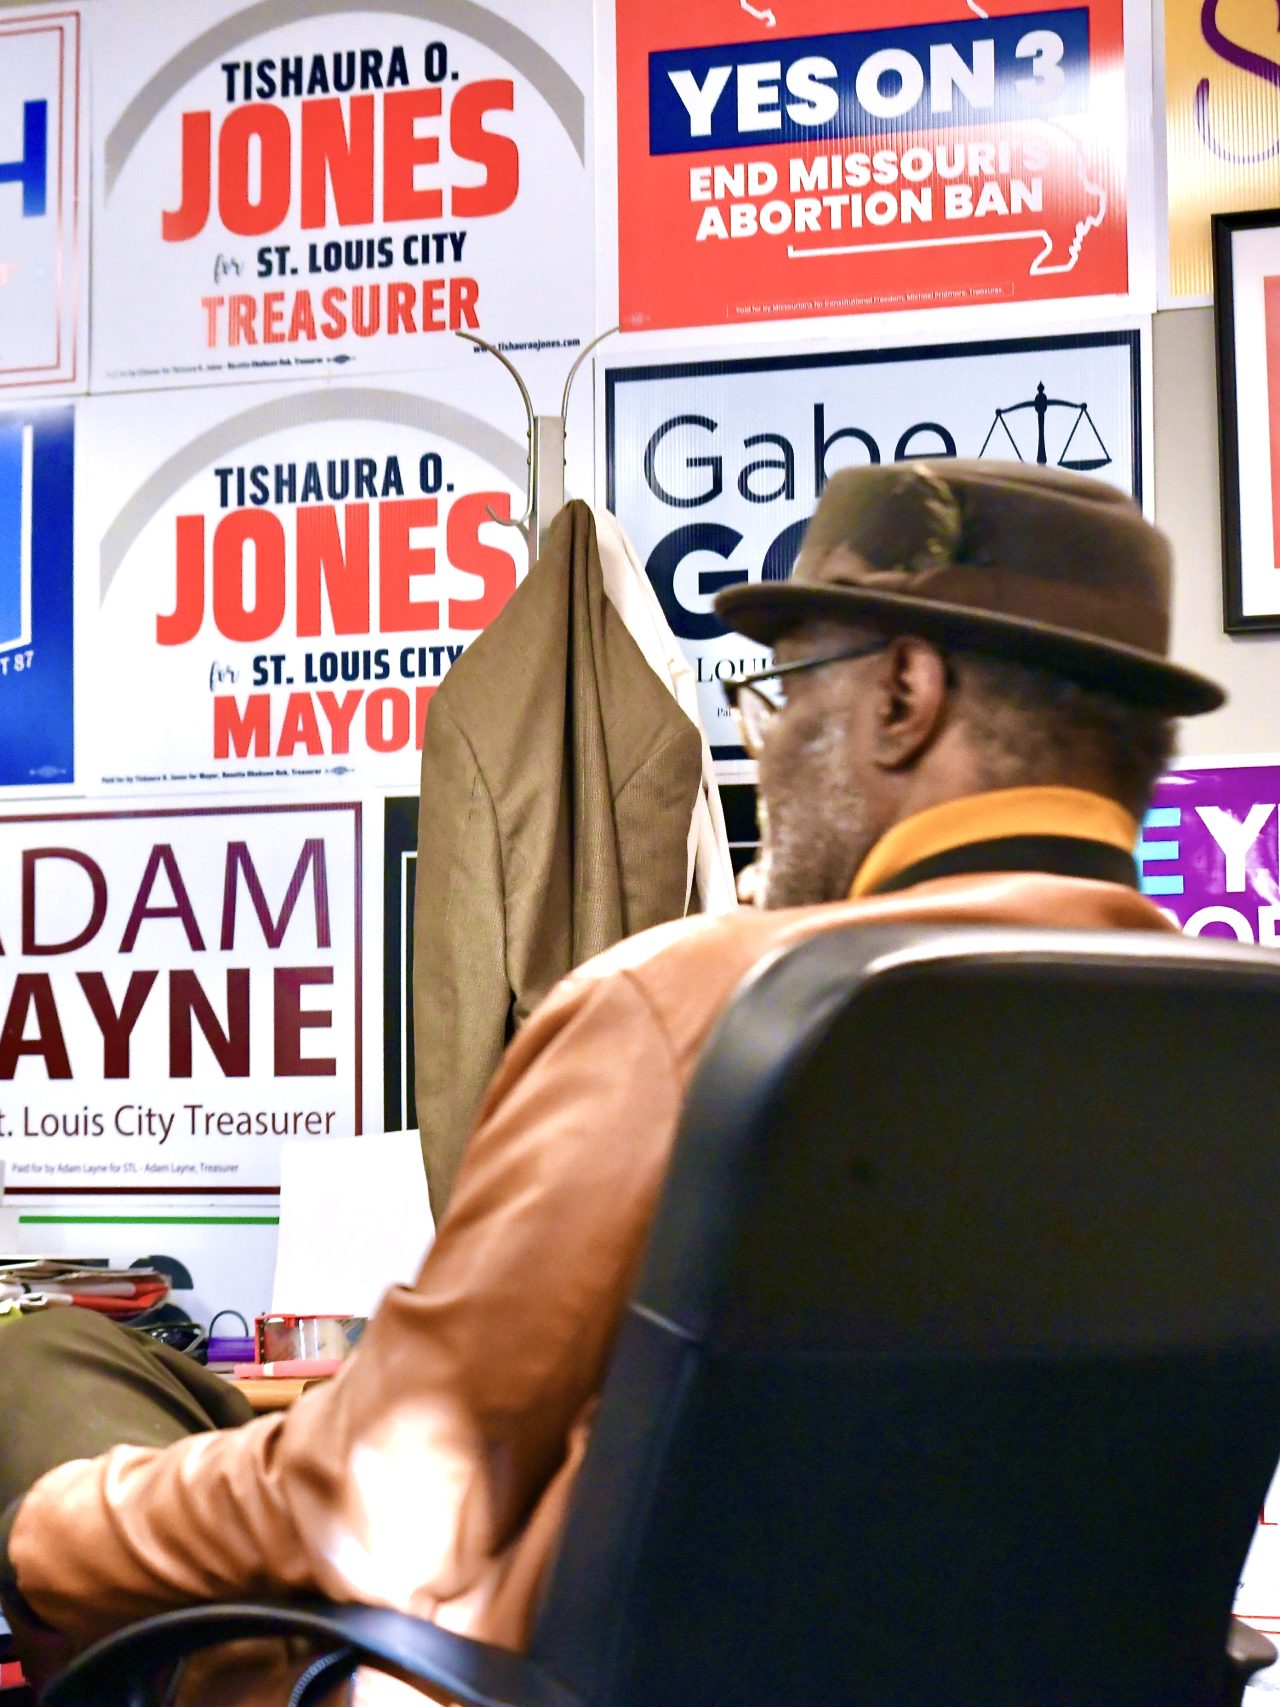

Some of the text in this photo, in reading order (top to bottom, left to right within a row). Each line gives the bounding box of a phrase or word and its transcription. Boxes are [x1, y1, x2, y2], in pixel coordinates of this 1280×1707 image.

[221, 41, 459, 102] TISHAURA O.
[667, 29, 1066, 137] YES ON 3
[161, 78, 520, 243] JONES
[689, 162, 778, 202] END
[696, 177, 1043, 242] ABORTION BAN
[213, 231, 467, 284] for ST. LOUIS CITY
[201, 277, 481, 349] TREASURER
[214, 452, 454, 508] TISHAURA O.
[155, 491, 517, 646] JONES
[13, 650, 34, 673] 87
[209, 645, 464, 692] for ST. LOUIS CITY
[23, 1105, 104, 1138] Louis
[114, 1104, 175, 1144] City
[184, 1103, 336, 1137] Treasurer
[11, 1163, 30, 1173] Paid
[31, 1163, 42, 1173] for
[45, 1163, 55, 1175] by
[57, 1163, 81, 1173] Adam
[83, 1163, 107, 1175] Layne
[109, 1162, 121, 1173] for
[123, 1162, 137, 1173] STL
[145, 1162, 169, 1173] Adam
[200, 1162, 239, 1173] Treasurer
